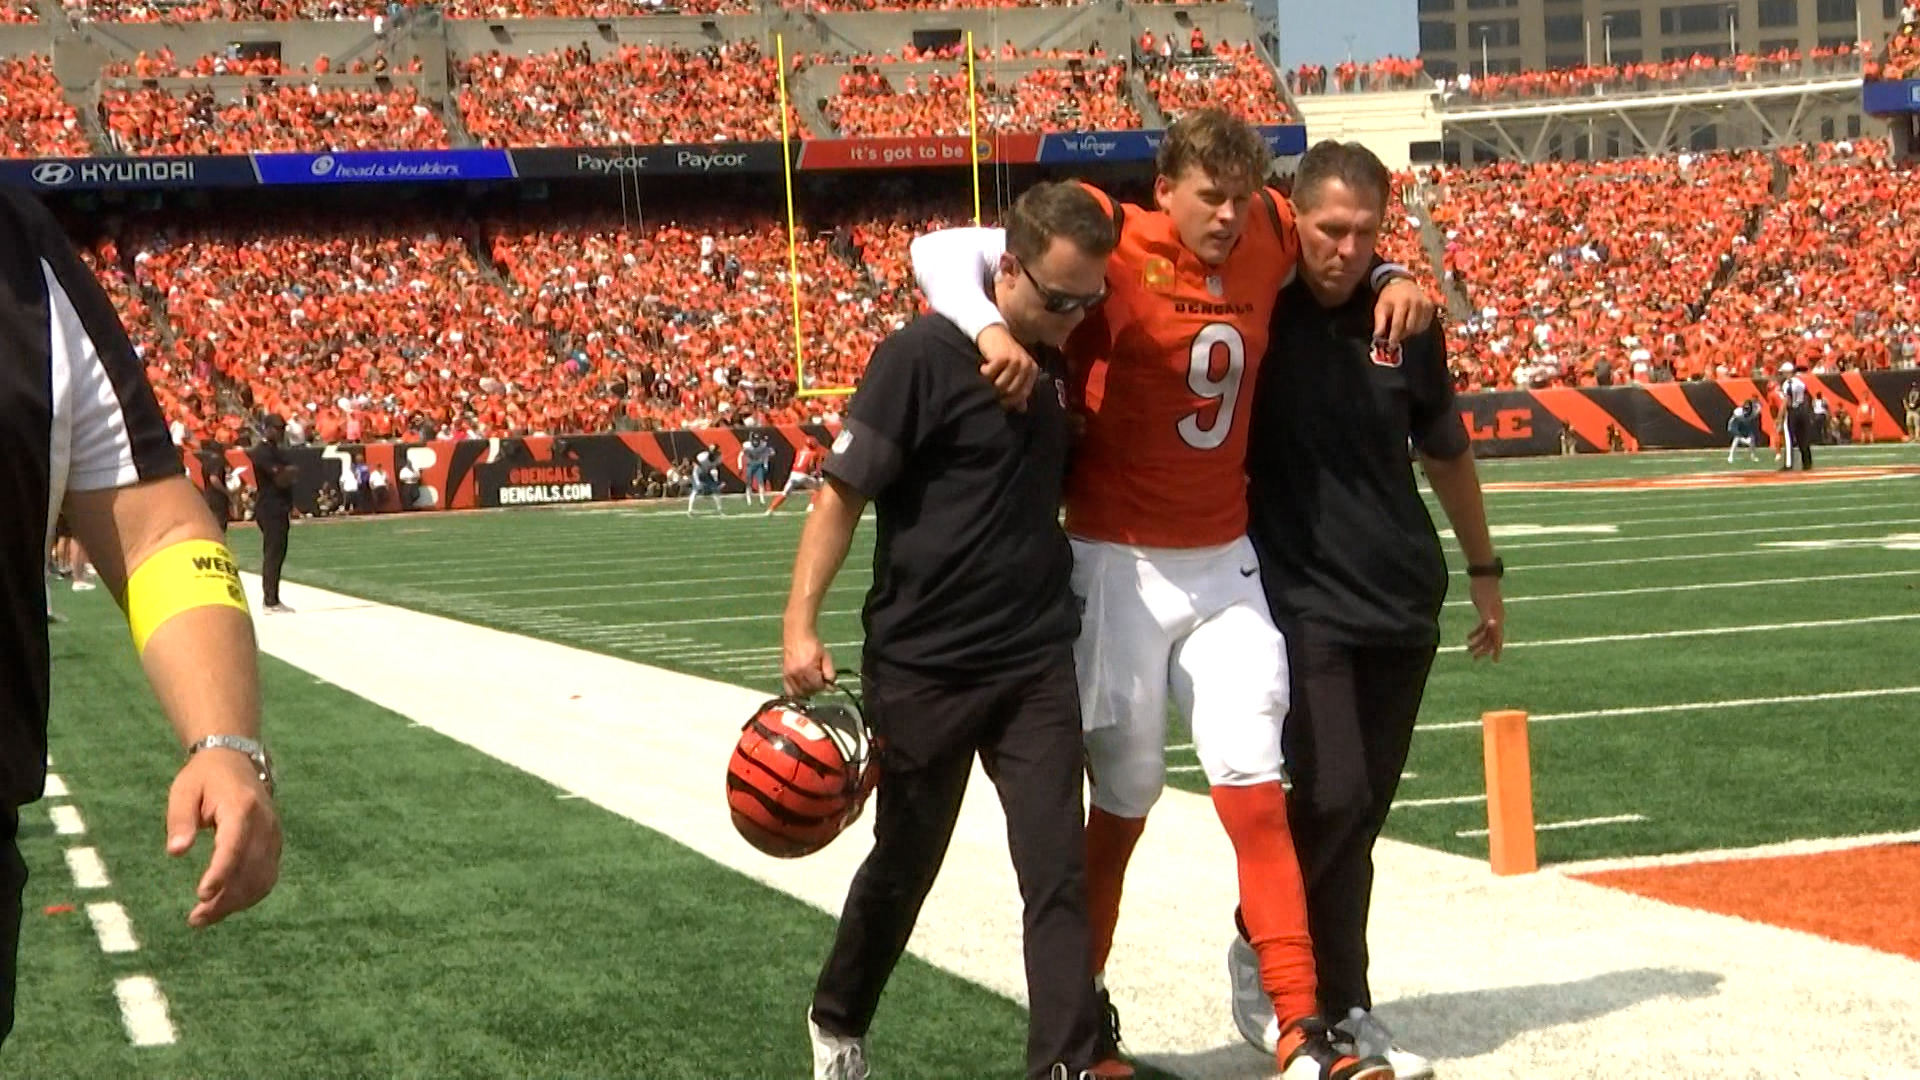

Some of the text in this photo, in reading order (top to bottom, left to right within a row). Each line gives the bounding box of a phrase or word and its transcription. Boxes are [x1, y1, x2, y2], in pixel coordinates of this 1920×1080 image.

[577, 153, 648, 174] Paycor
[677, 151, 747, 171] Paycor
[850, 143, 964, 163] It's got to be
[81, 161, 195, 182] HYUNDAI
[1175, 302, 1254, 316] BENGALS
[1176, 321, 1246, 450] 9
[499, 483, 592, 504] BENGALS.COM
